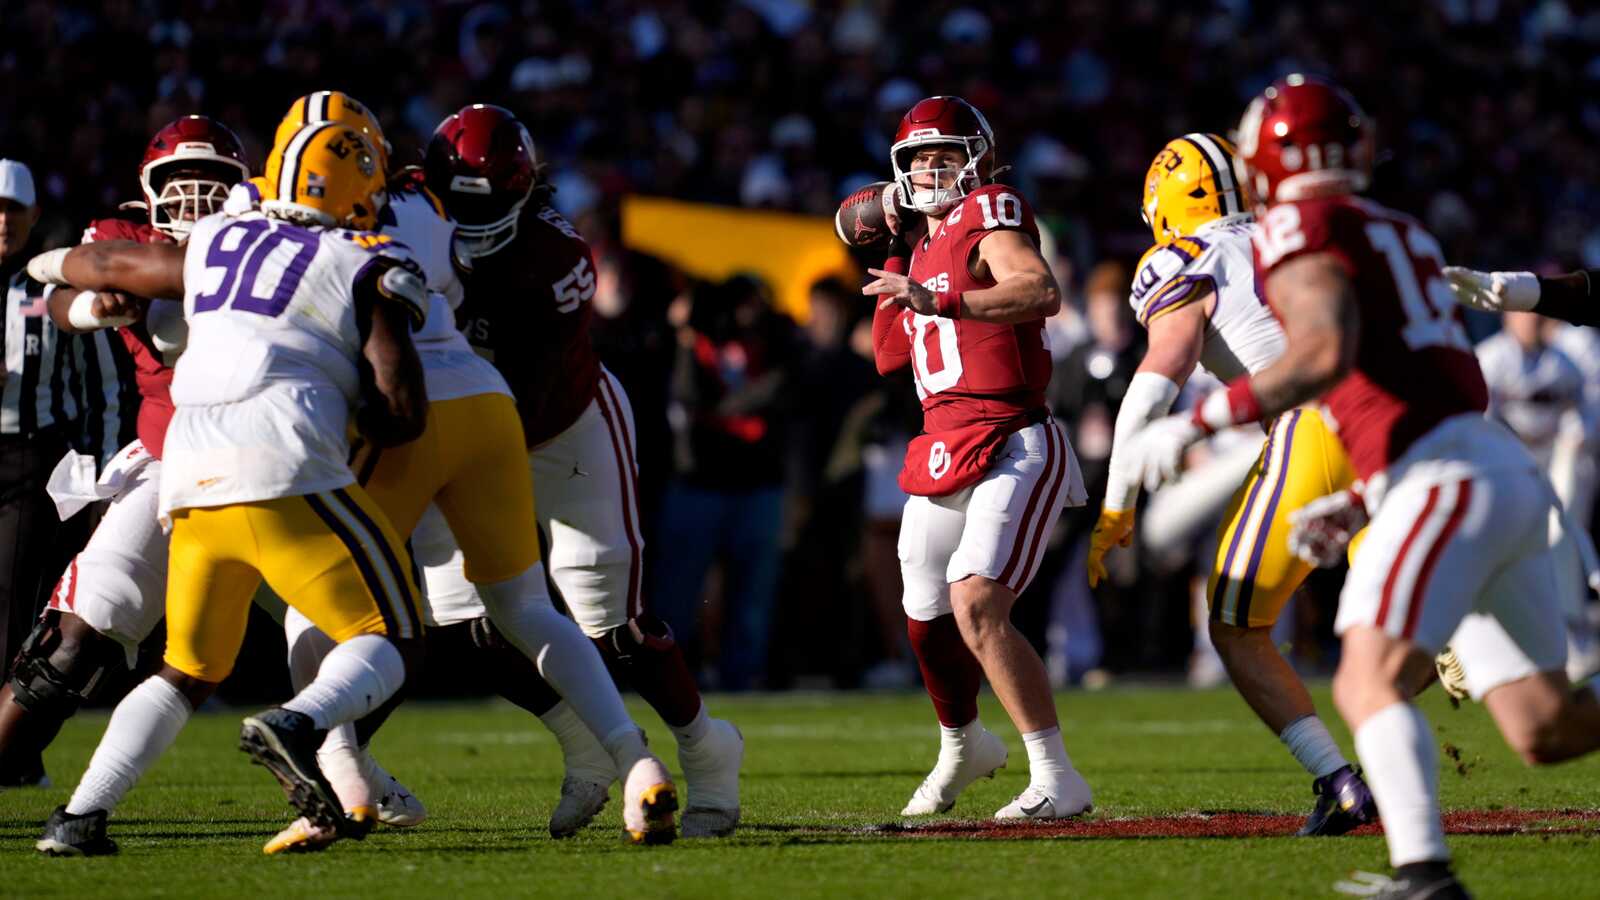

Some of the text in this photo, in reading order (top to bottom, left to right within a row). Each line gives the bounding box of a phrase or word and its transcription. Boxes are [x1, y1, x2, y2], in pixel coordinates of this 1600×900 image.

[976, 192, 1022, 230] 10
[1252, 206, 1306, 269] 12
[194, 219, 320, 318] 90
[552, 256, 597, 314] 55
[26, 333, 40, 356] R
[927, 441, 951, 480] OU
